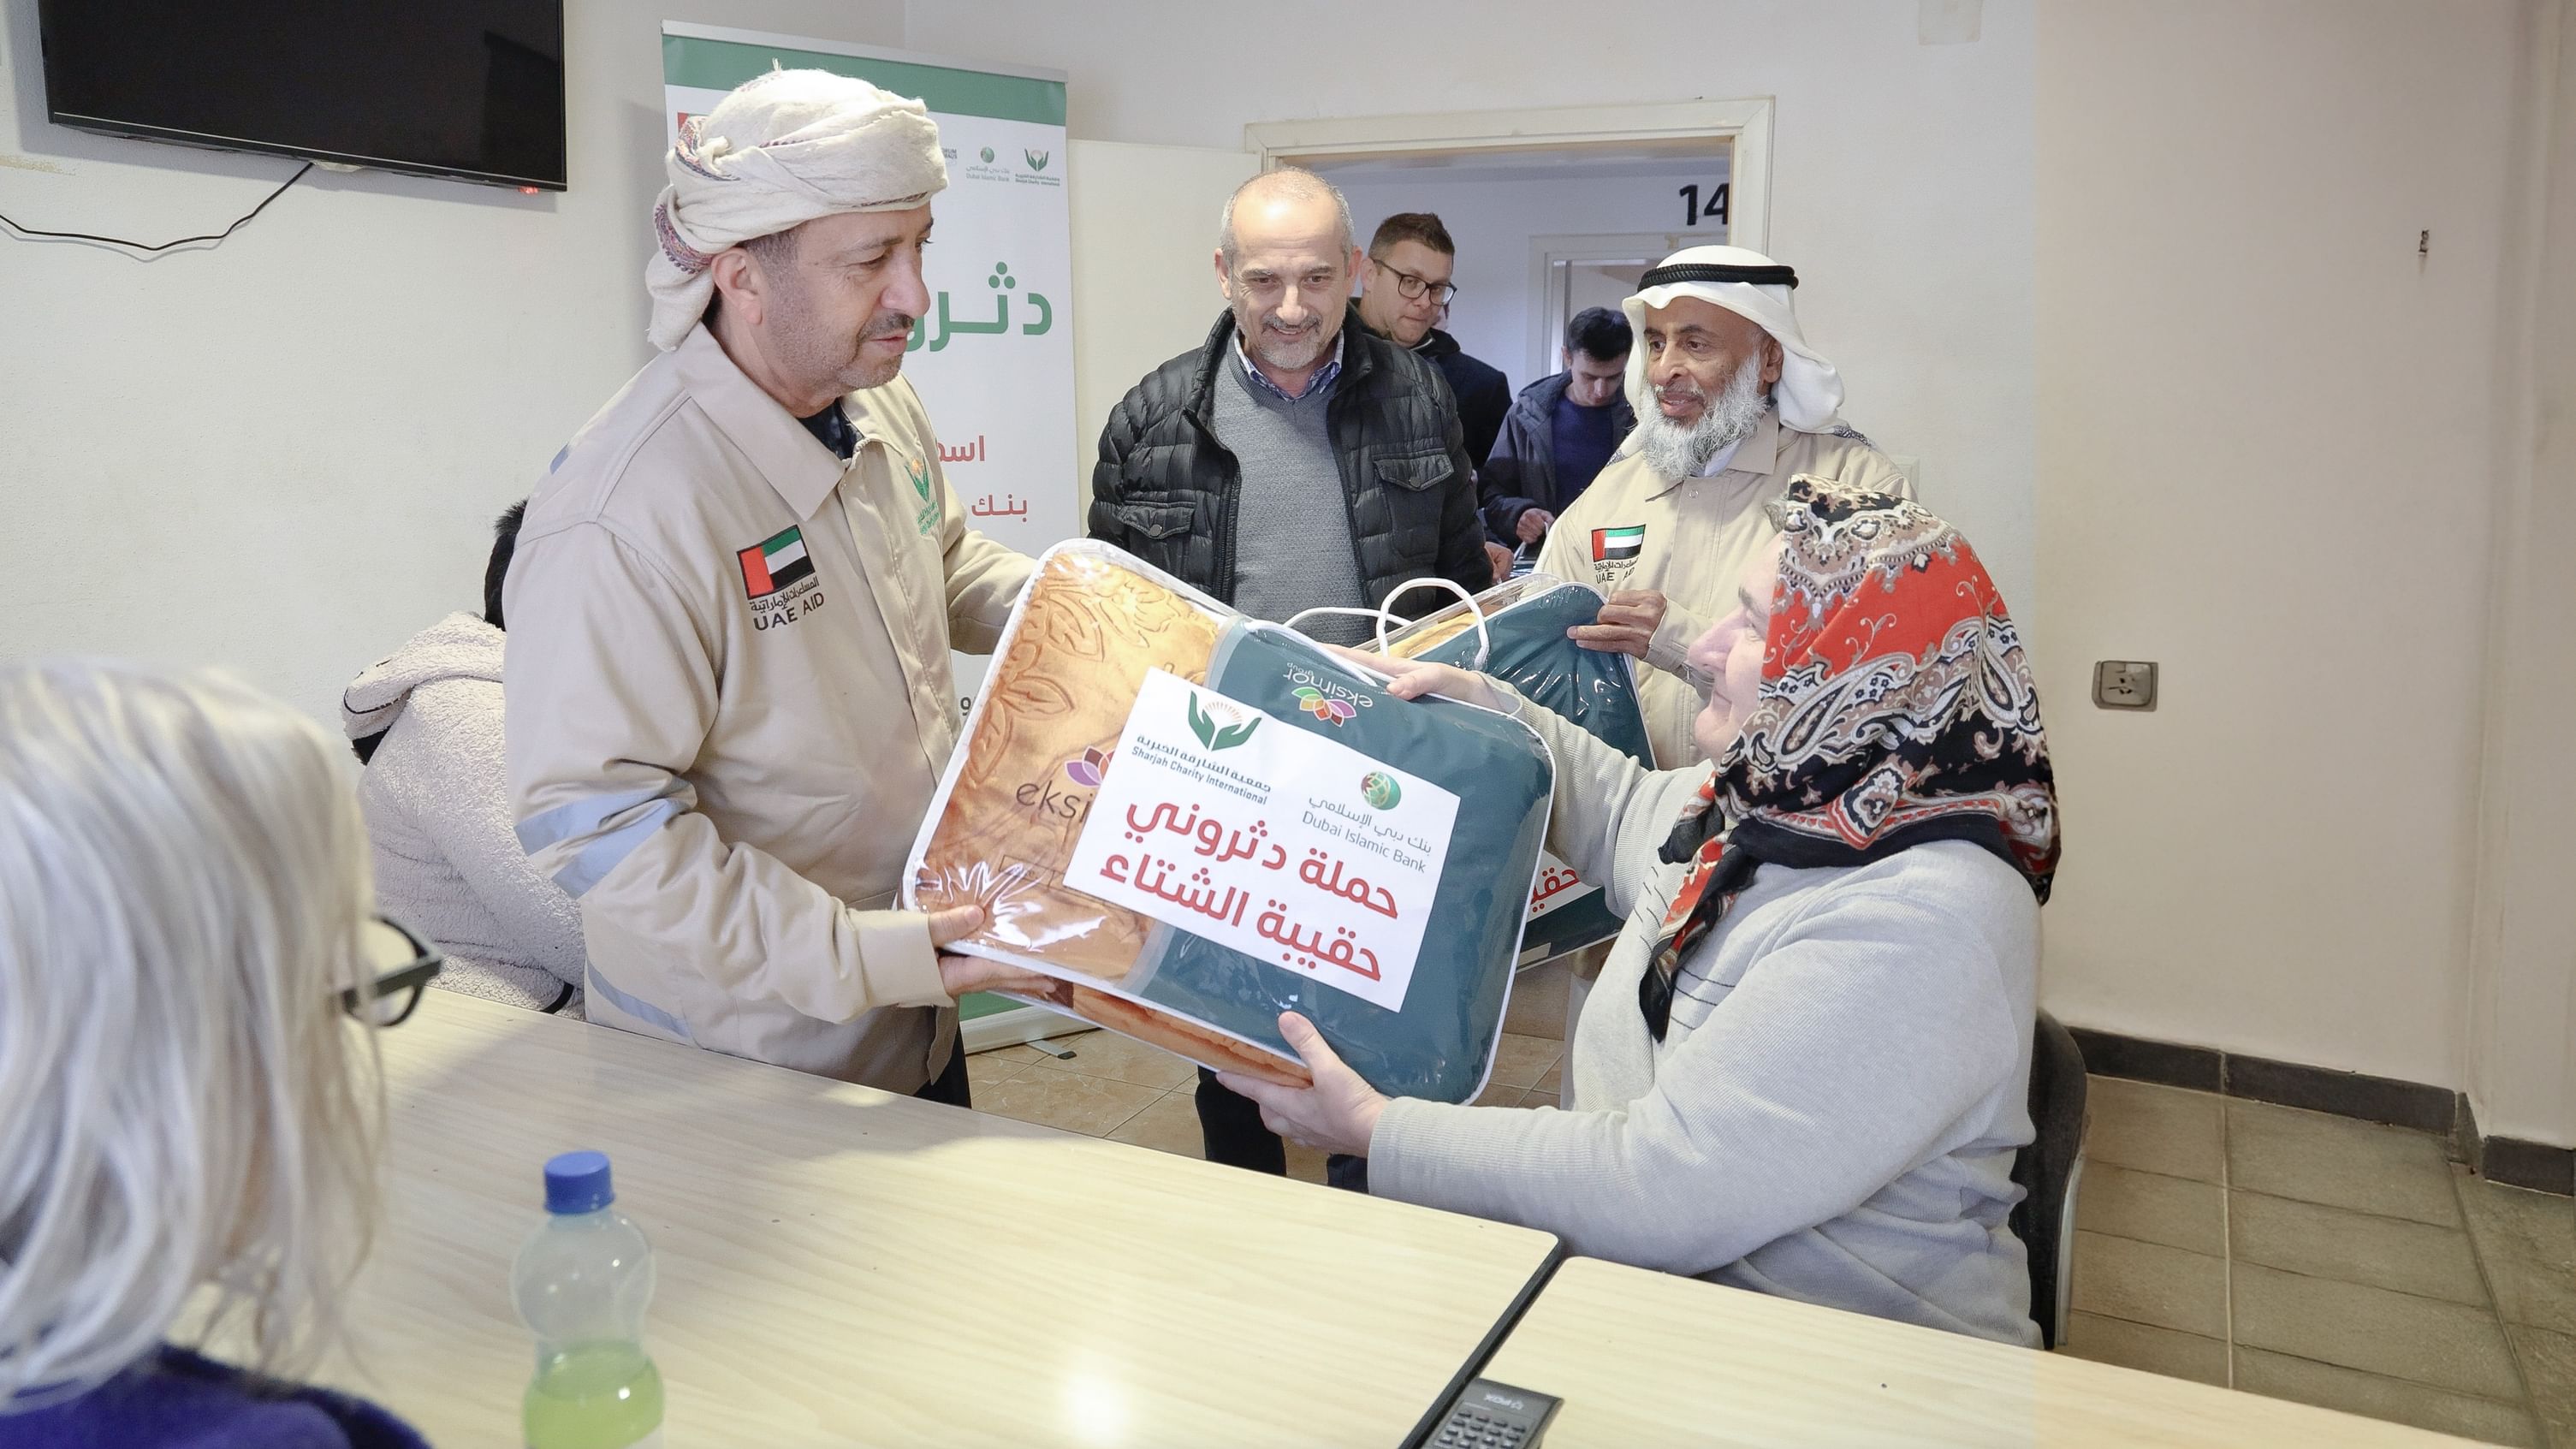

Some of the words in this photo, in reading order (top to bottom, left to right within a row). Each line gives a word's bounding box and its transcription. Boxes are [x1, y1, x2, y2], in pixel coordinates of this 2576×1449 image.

[1679, 182, 1730, 226] 14
[971, 494, 1027, 522] بنك
[1596, 572, 1615, 584] UAE
[753, 607, 798, 631] UAE
[803, 592, 825, 615] AID
[1283, 668, 1374, 708] eksimor
[1286, 662, 1315, 676] group
[1131, 745, 1168, 767] Sharjah
[1170, 761, 1205, 782] Charity
[1206, 775, 1268, 805] International
[1016, 780, 1094, 823] eksi
[1309, 798, 1373, 828] الإسلامي
[1125, 802, 1287, 870] دثروني
[1303, 811, 1344, 837] Dubai
[1344, 828, 1391, 858] Islamic
[1393, 849, 1427, 873] Bank
[1374, 825, 1404, 842] دبي
[1408, 836, 1432, 857] بنك
[1100, 852, 1250, 928] الشتاء
[1299, 847, 1398, 920] حملة
[1256, 899, 1381, 982] حقيبة
